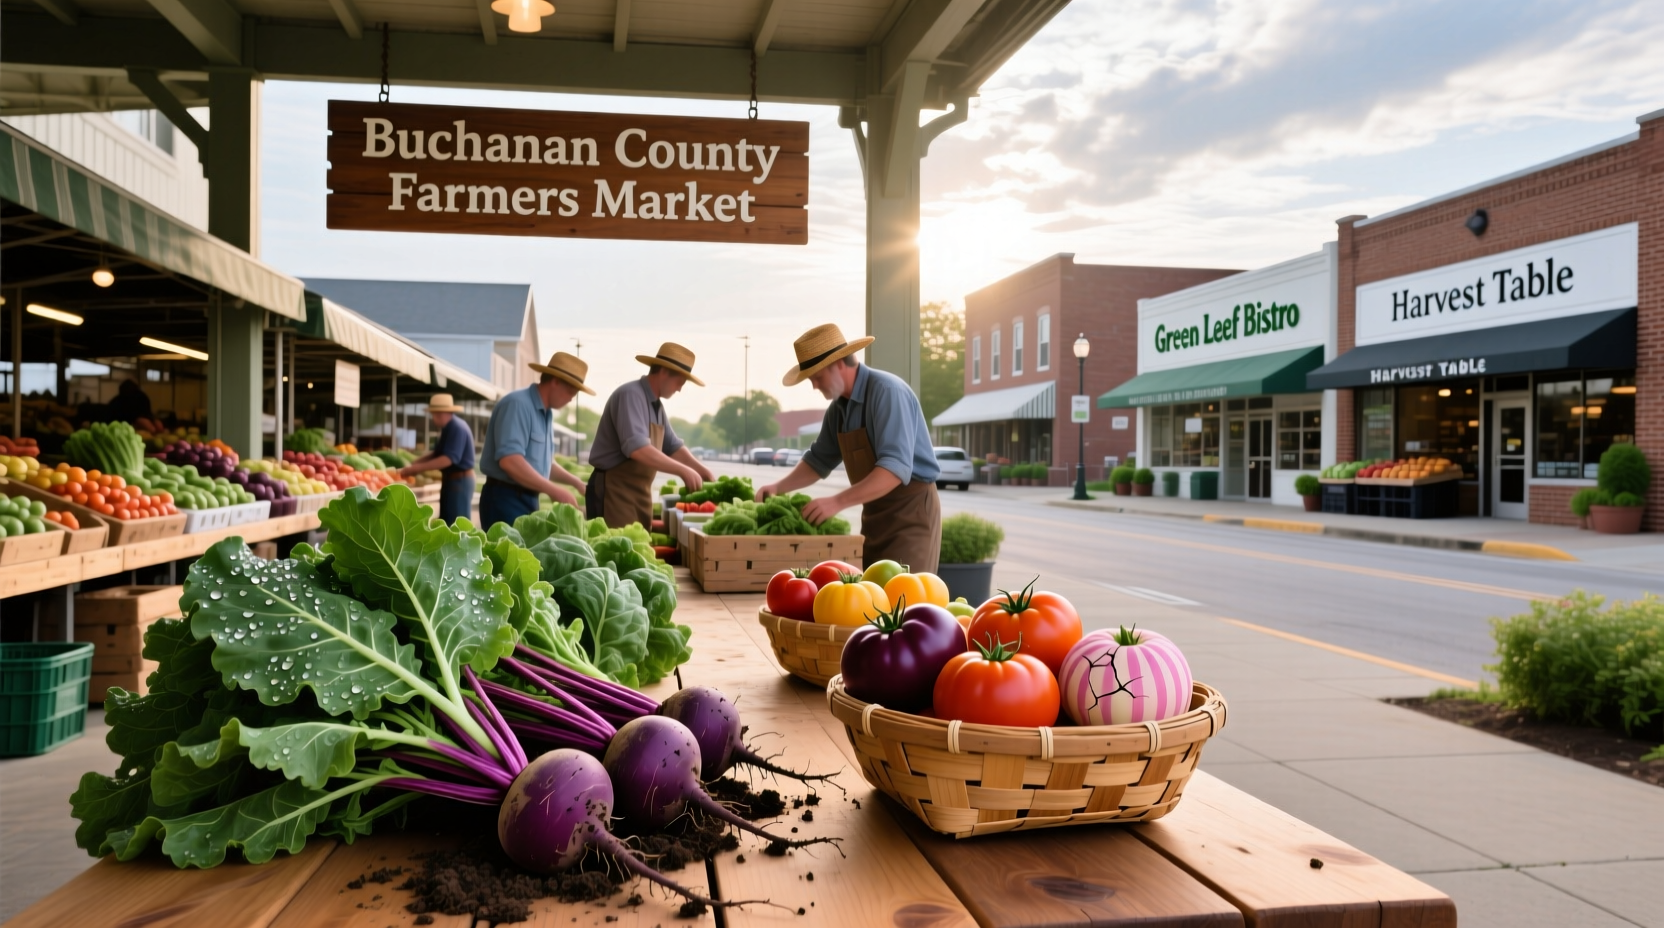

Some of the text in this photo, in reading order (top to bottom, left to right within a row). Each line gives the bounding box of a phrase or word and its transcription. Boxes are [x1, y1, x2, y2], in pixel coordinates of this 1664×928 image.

[362, 117, 780, 184] Buchanan County
[388, 173, 756, 222] Farmers Market
[1392, 257, 1574, 322] Harvest Table
[1154, 323, 1199, 353] Green
[1243, 301, 1300, 337] Bistro
